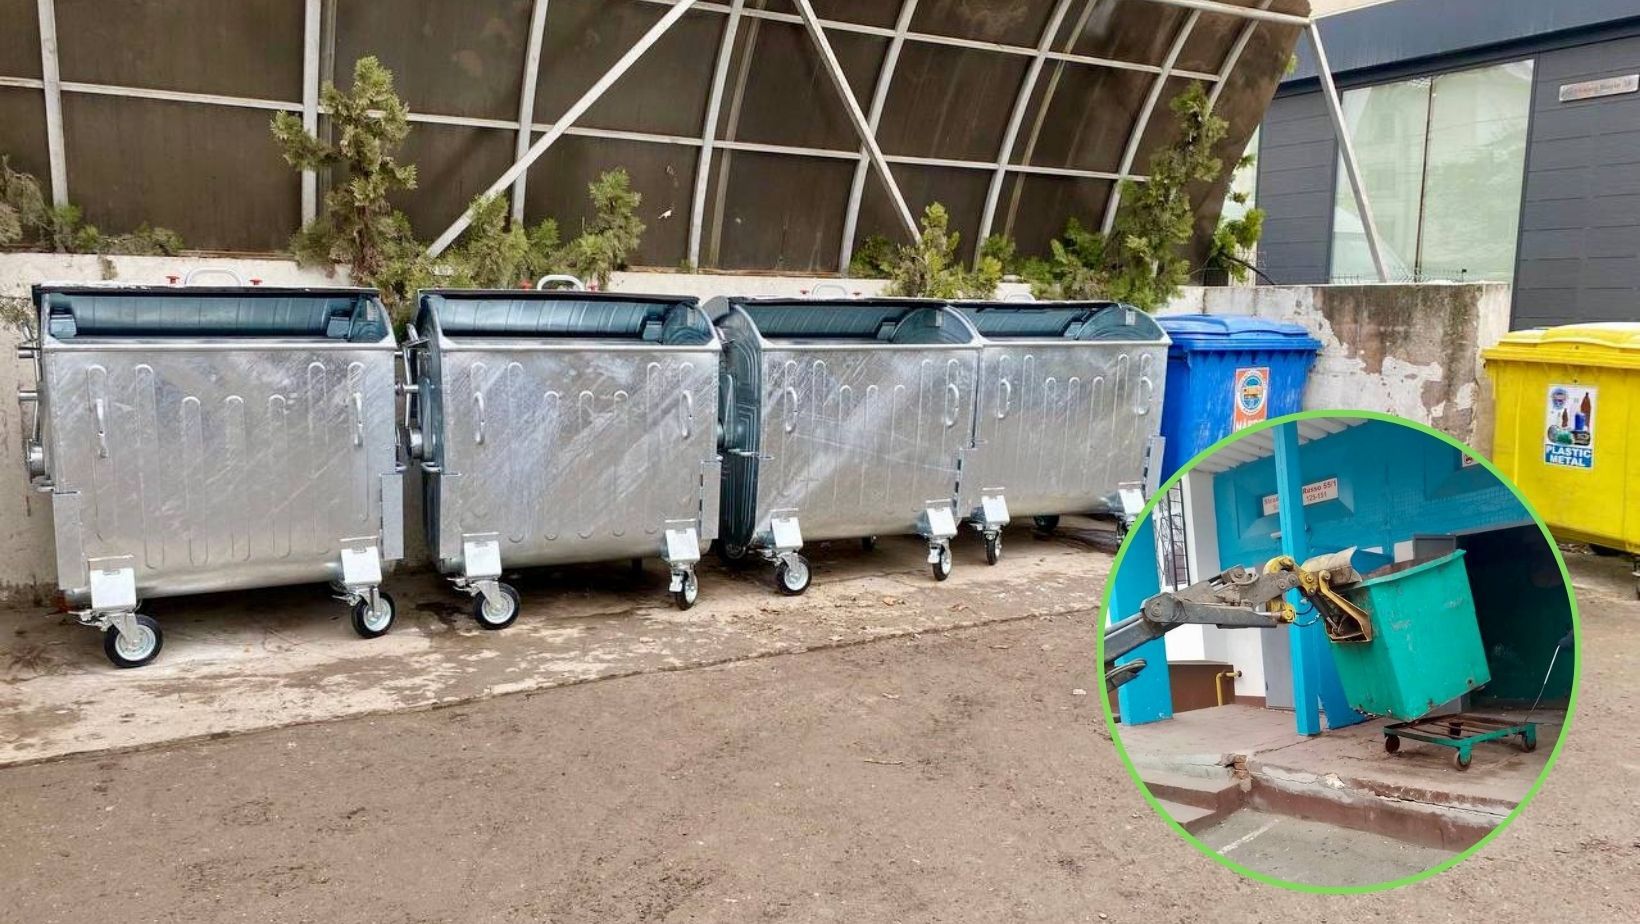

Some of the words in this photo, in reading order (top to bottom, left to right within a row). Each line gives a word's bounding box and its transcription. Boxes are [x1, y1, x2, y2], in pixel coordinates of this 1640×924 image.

[1545, 445, 1591, 458] PLASTIC
[1549, 455, 1585, 466] METAL
[1302, 486, 1322, 494] Russo
